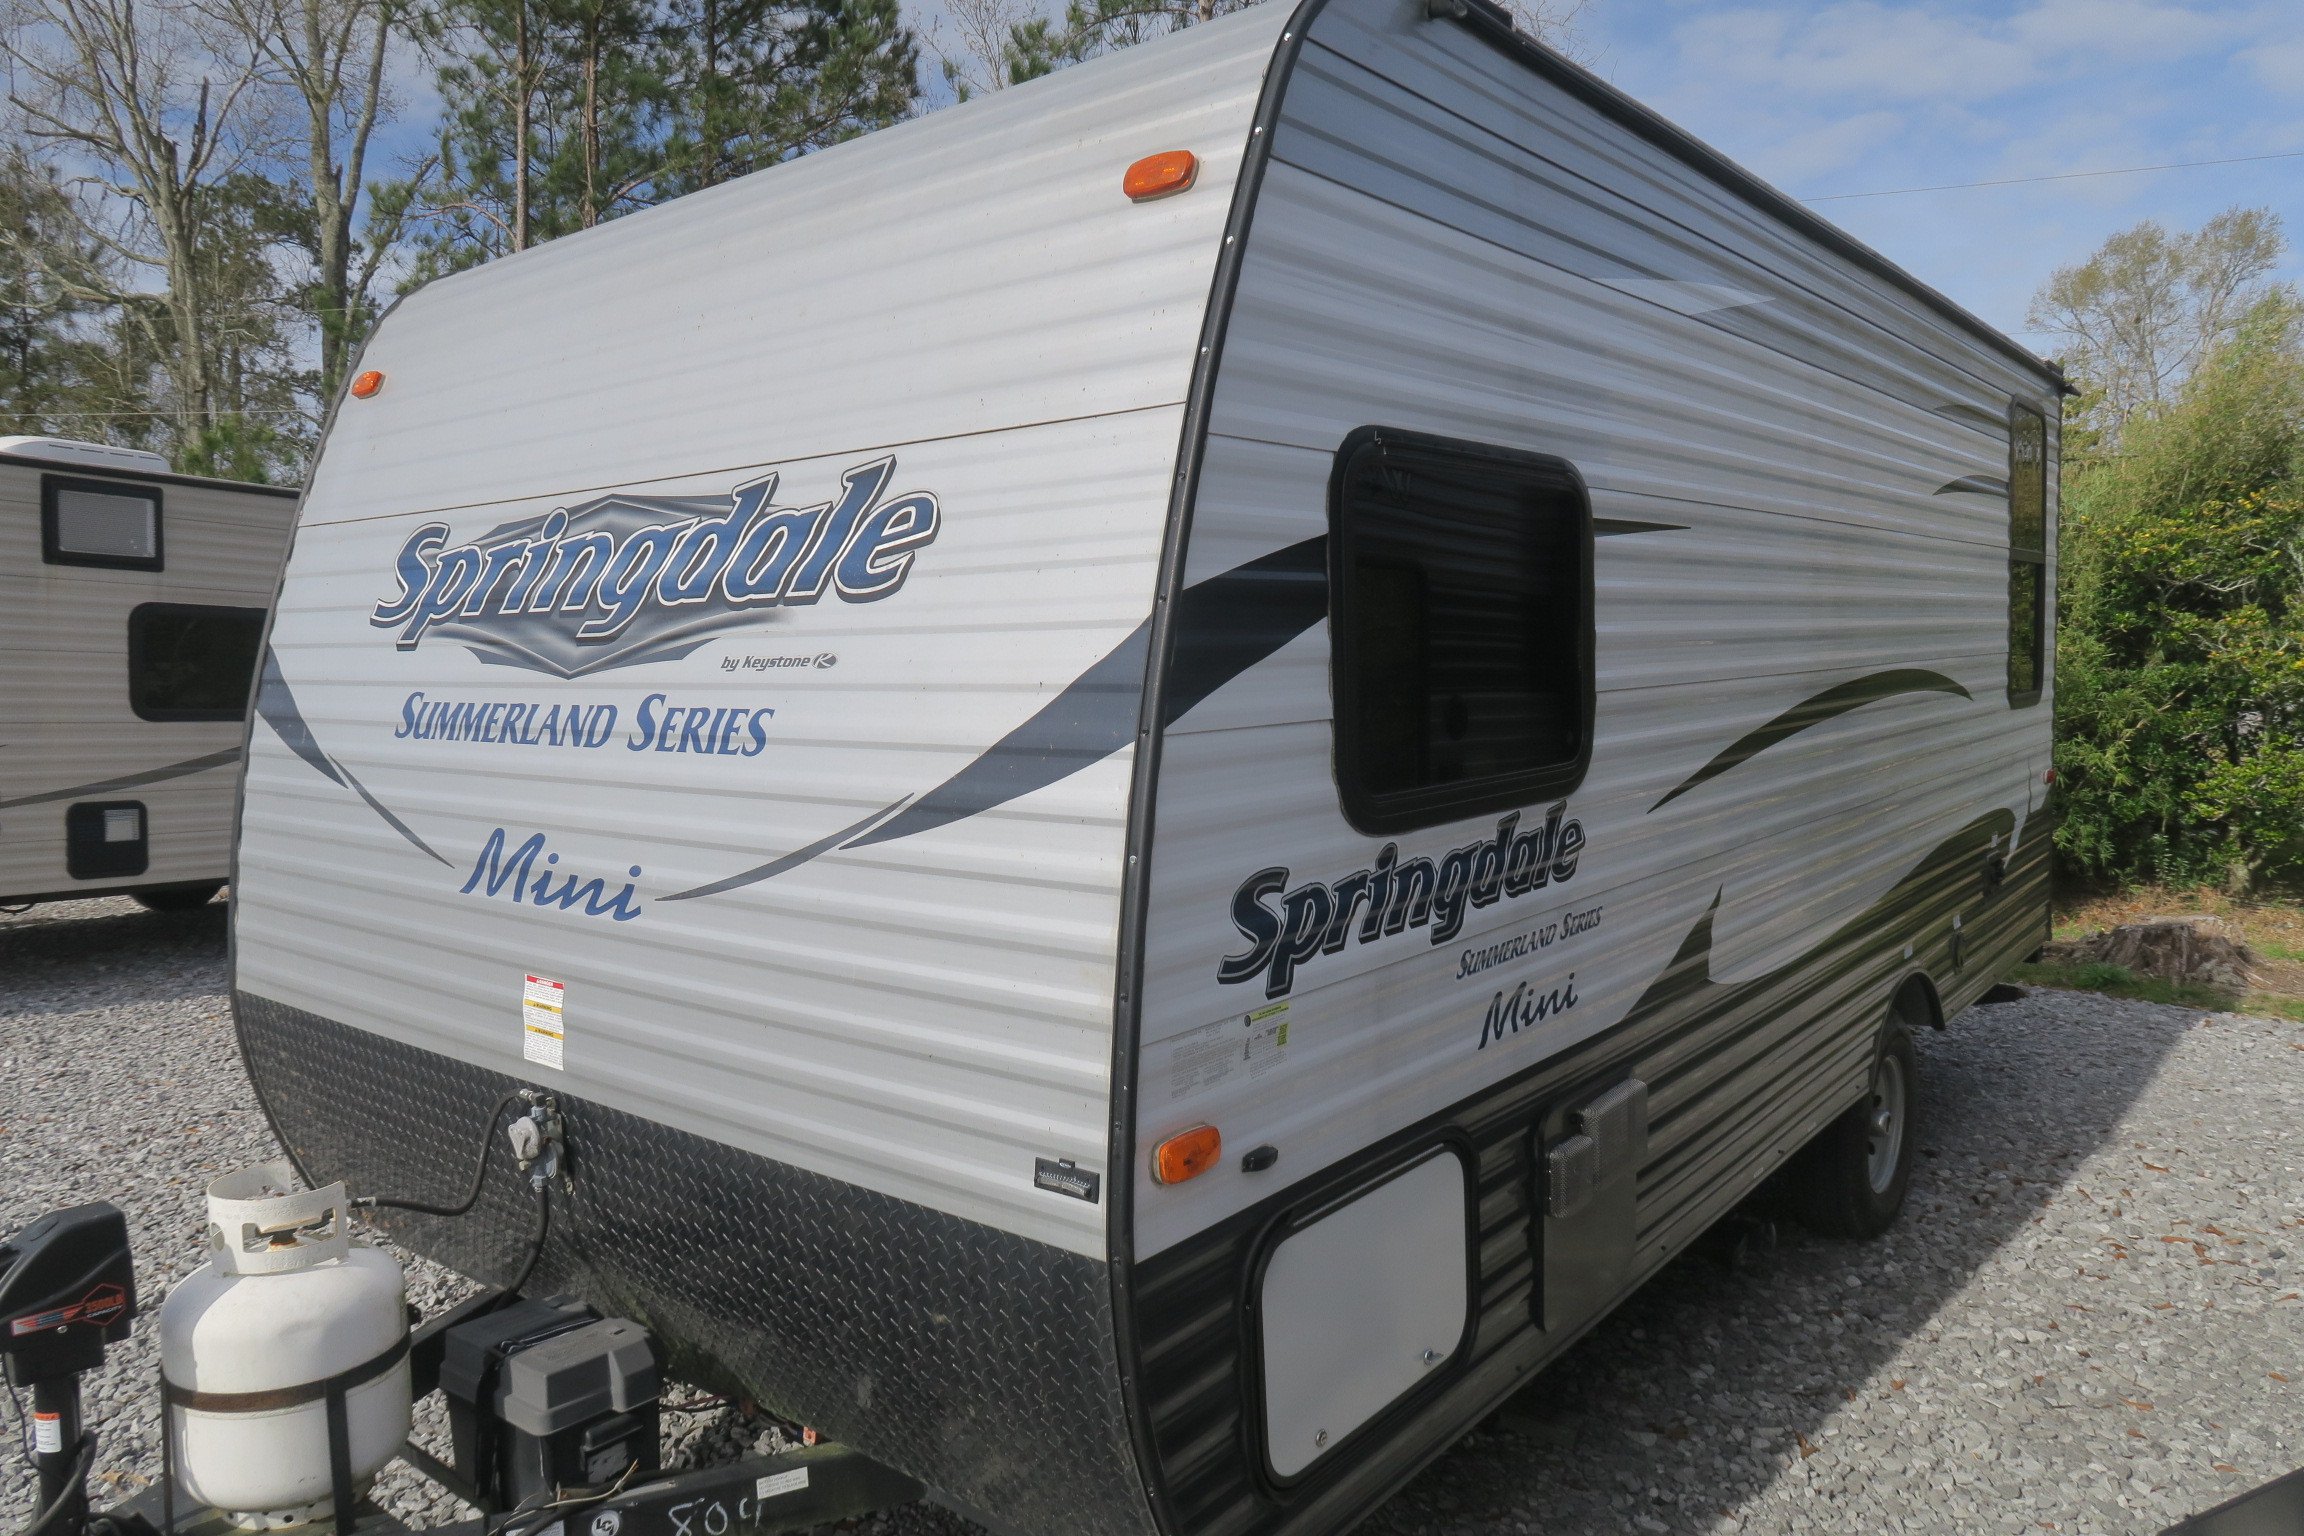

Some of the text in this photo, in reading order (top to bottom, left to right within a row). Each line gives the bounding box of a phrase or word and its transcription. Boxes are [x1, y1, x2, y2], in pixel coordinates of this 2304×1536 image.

[371, 453, 941, 651] Springdale
[720, 656, 741, 672] by
[742, 655, 811, 671] Keystone
[394, 691, 775, 757] SUMMERLAND SERIES
[460, 827, 644, 921] Mini
[1216, 800, 1585, 1000] Springdale
[1456, 906, 1603, 980] SUMMERLAND SERIES
[1478, 972, 1578, 1051] Mini
